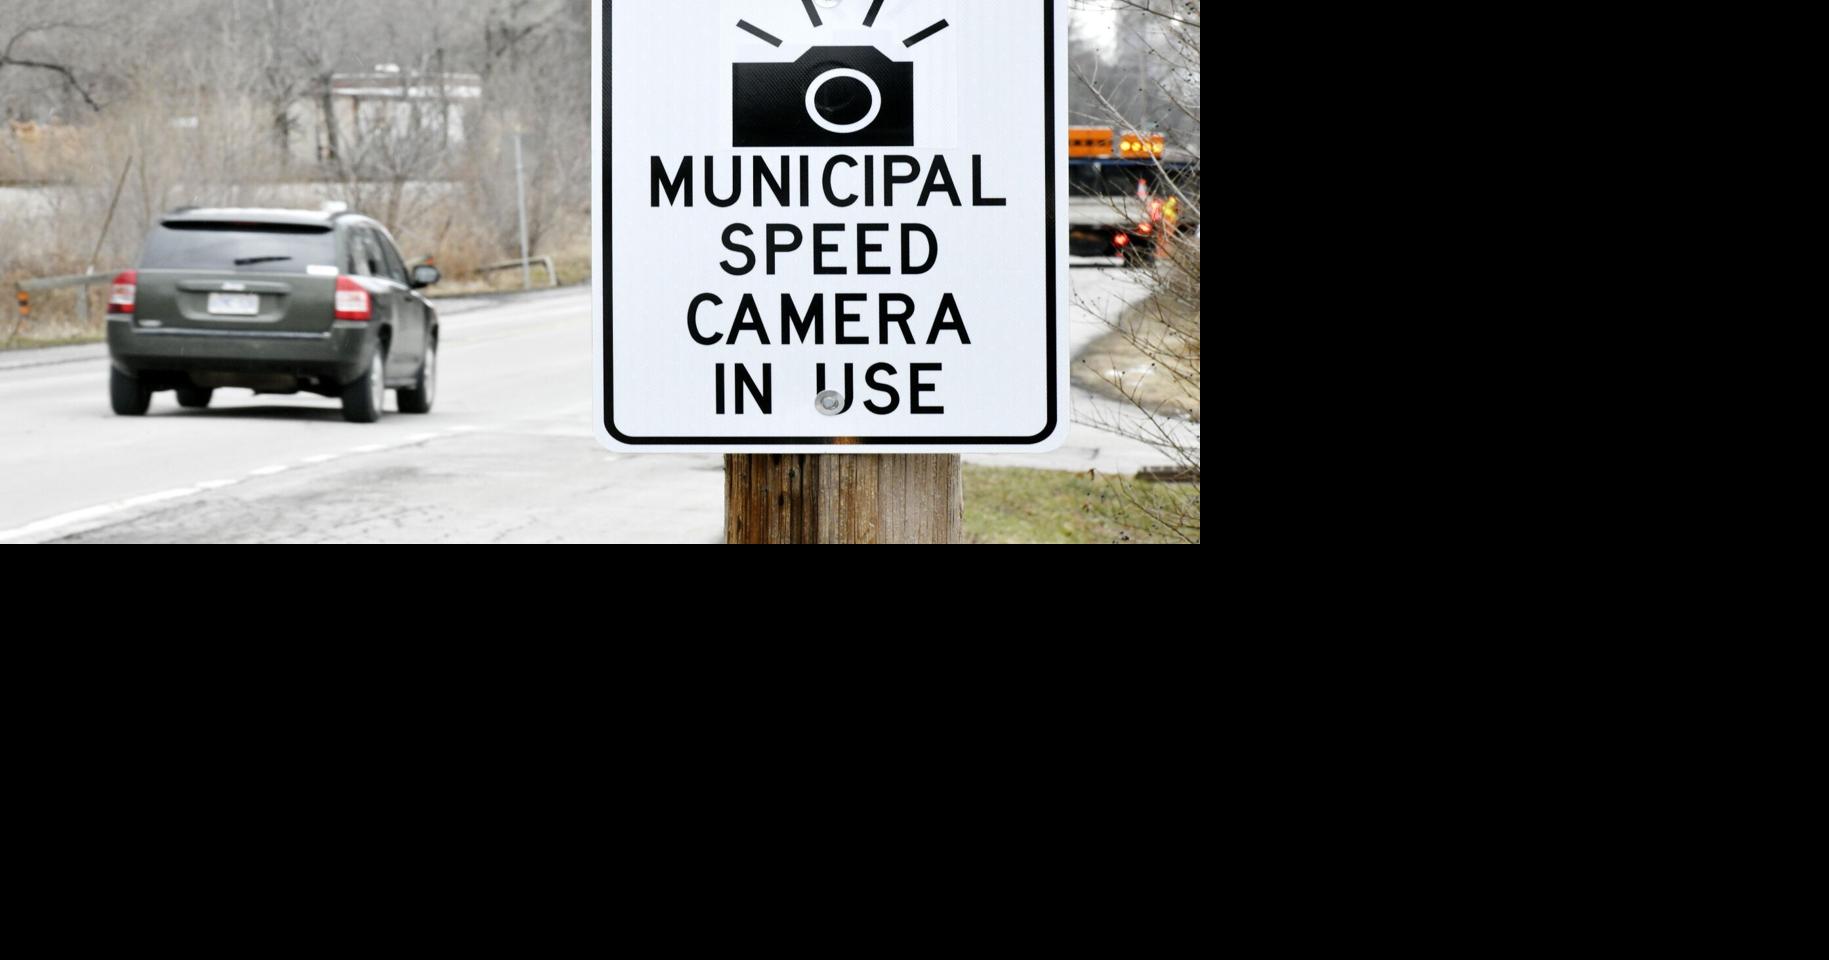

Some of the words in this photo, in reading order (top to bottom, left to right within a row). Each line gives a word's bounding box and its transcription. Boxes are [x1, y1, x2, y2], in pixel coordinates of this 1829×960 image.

[650, 154, 1007, 207] MUNICIPAL
[719, 222, 938, 276] SPEED
[686, 292, 972, 345] CAMERA
[715, 362, 772, 415] IN
[816, 361, 945, 416] USE
